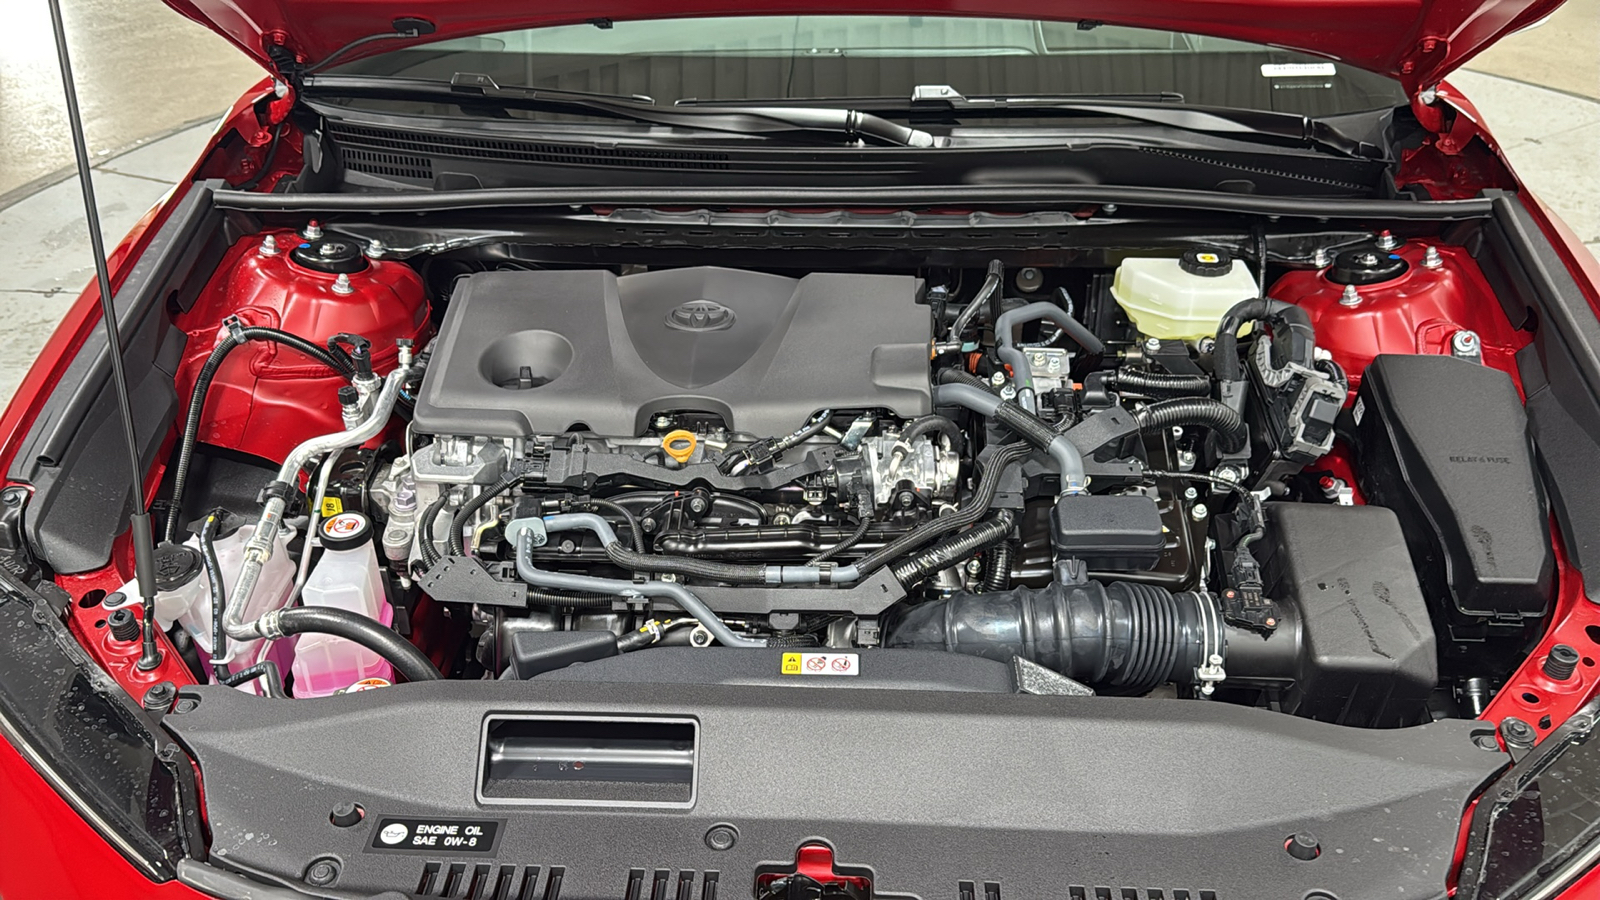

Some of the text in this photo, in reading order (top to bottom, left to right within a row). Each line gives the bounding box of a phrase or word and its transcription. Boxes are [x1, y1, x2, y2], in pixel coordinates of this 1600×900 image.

[1486, 456, 1511, 464] FUSE
[326, 503, 335, 512] J8
[416, 825, 483, 835] ENGINE OIL
[412, 836, 477, 846] SAE 0W-8
